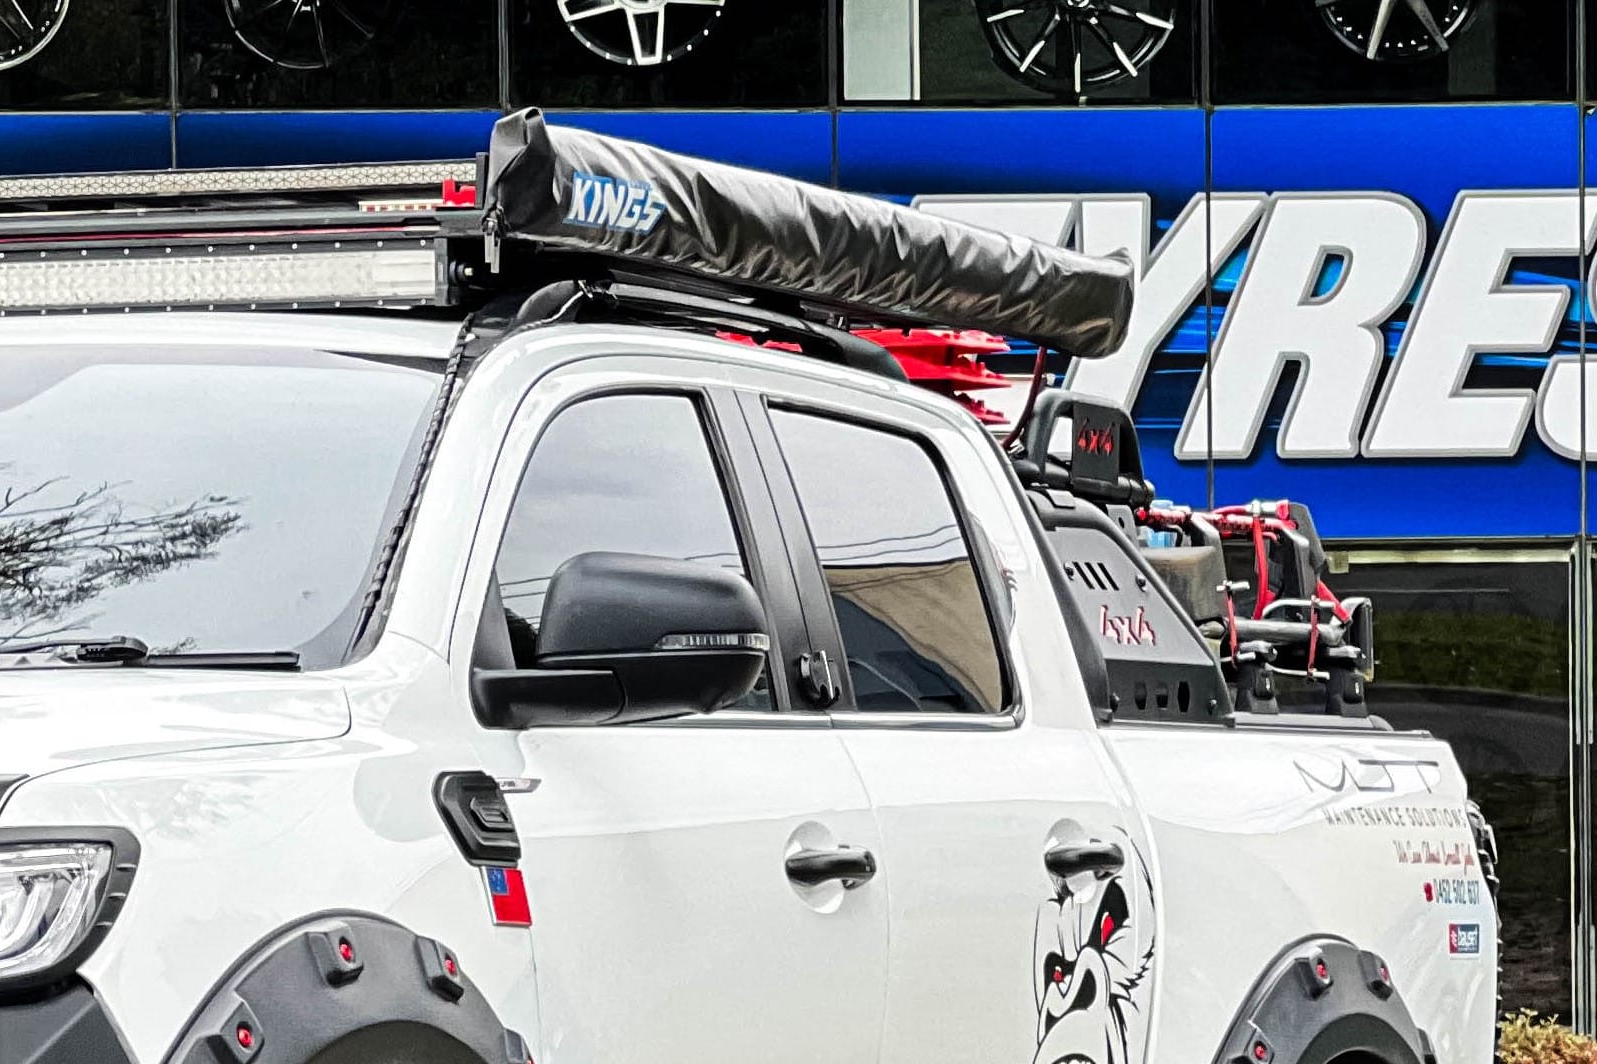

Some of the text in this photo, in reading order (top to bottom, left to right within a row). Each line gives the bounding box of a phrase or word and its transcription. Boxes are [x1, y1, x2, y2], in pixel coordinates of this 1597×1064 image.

[567, 177, 665, 232] KINGS
[1325, 806, 1467, 829] MAINTENANCE SOLUTIONS
